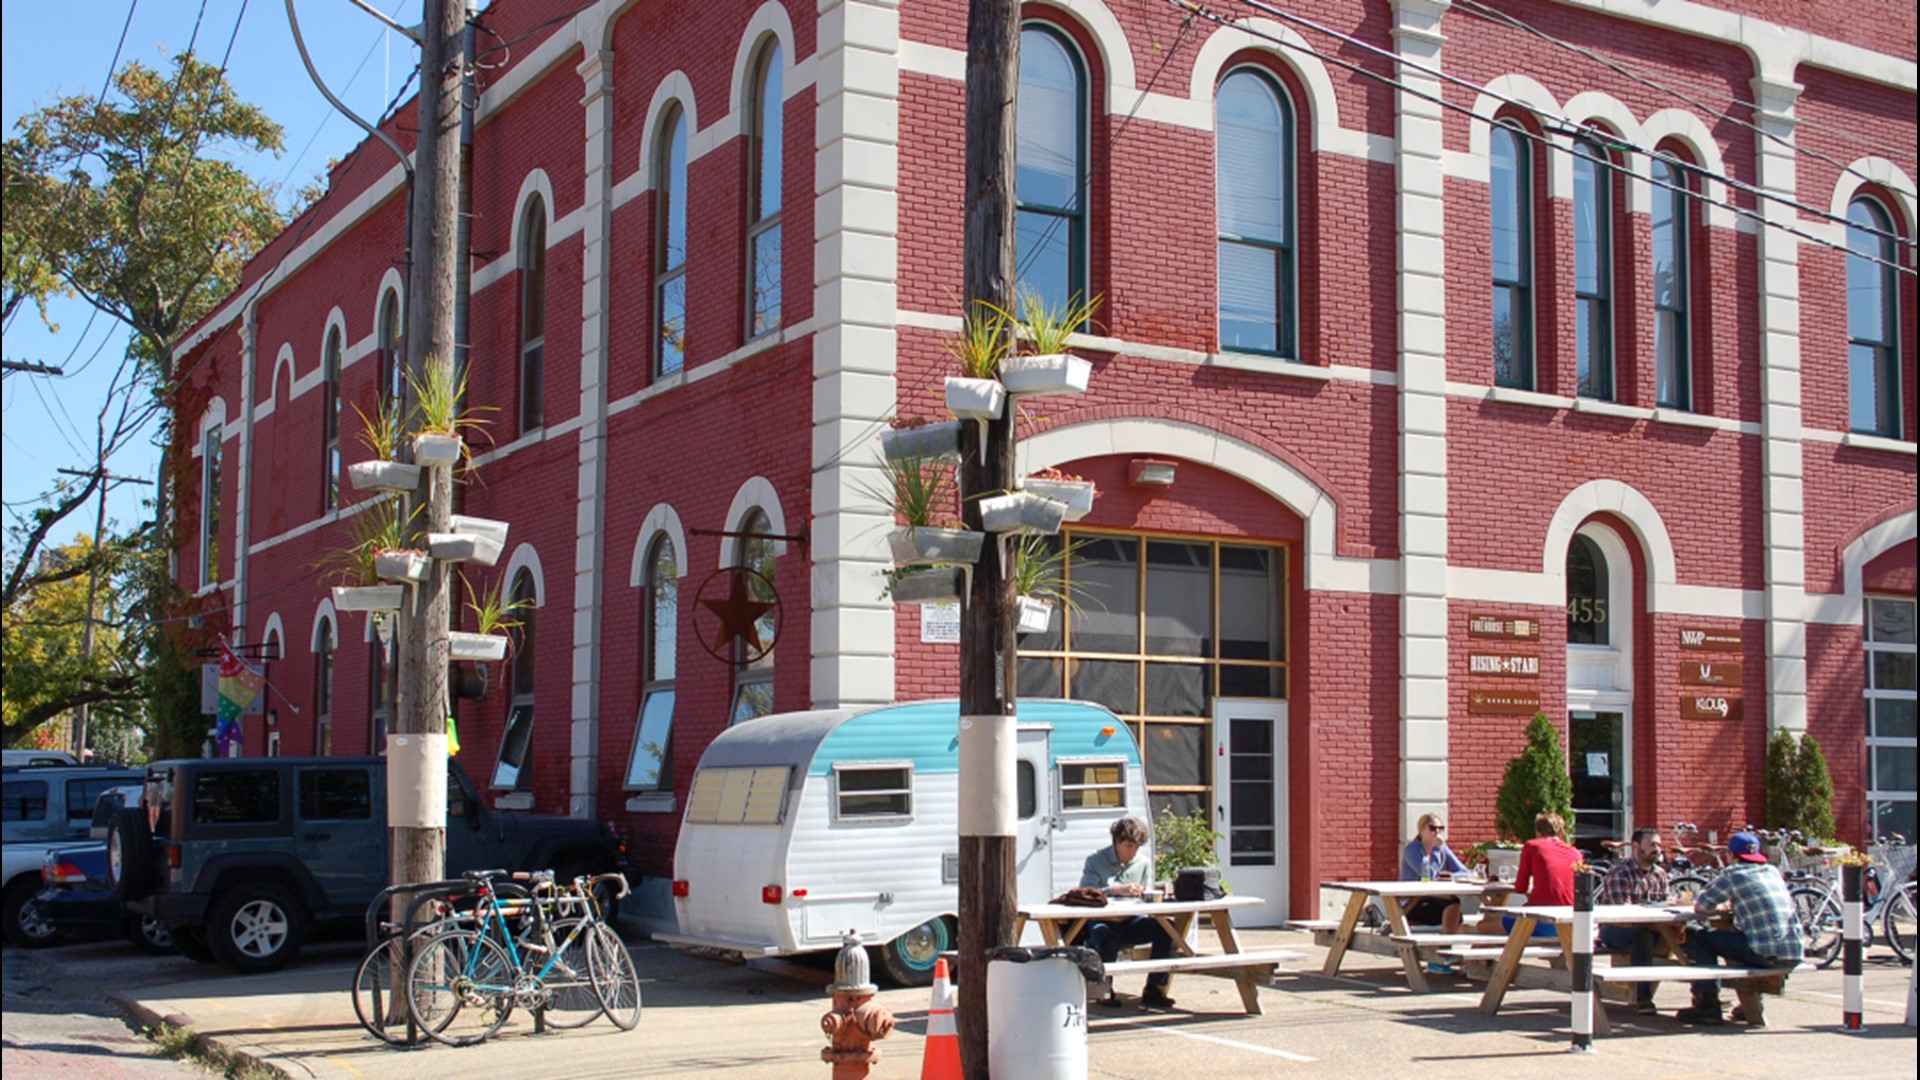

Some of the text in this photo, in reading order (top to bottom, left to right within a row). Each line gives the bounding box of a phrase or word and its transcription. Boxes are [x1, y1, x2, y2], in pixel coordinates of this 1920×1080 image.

[1568, 598, 1606, 623] 455
[1470, 655, 1539, 674] RISING STAR
